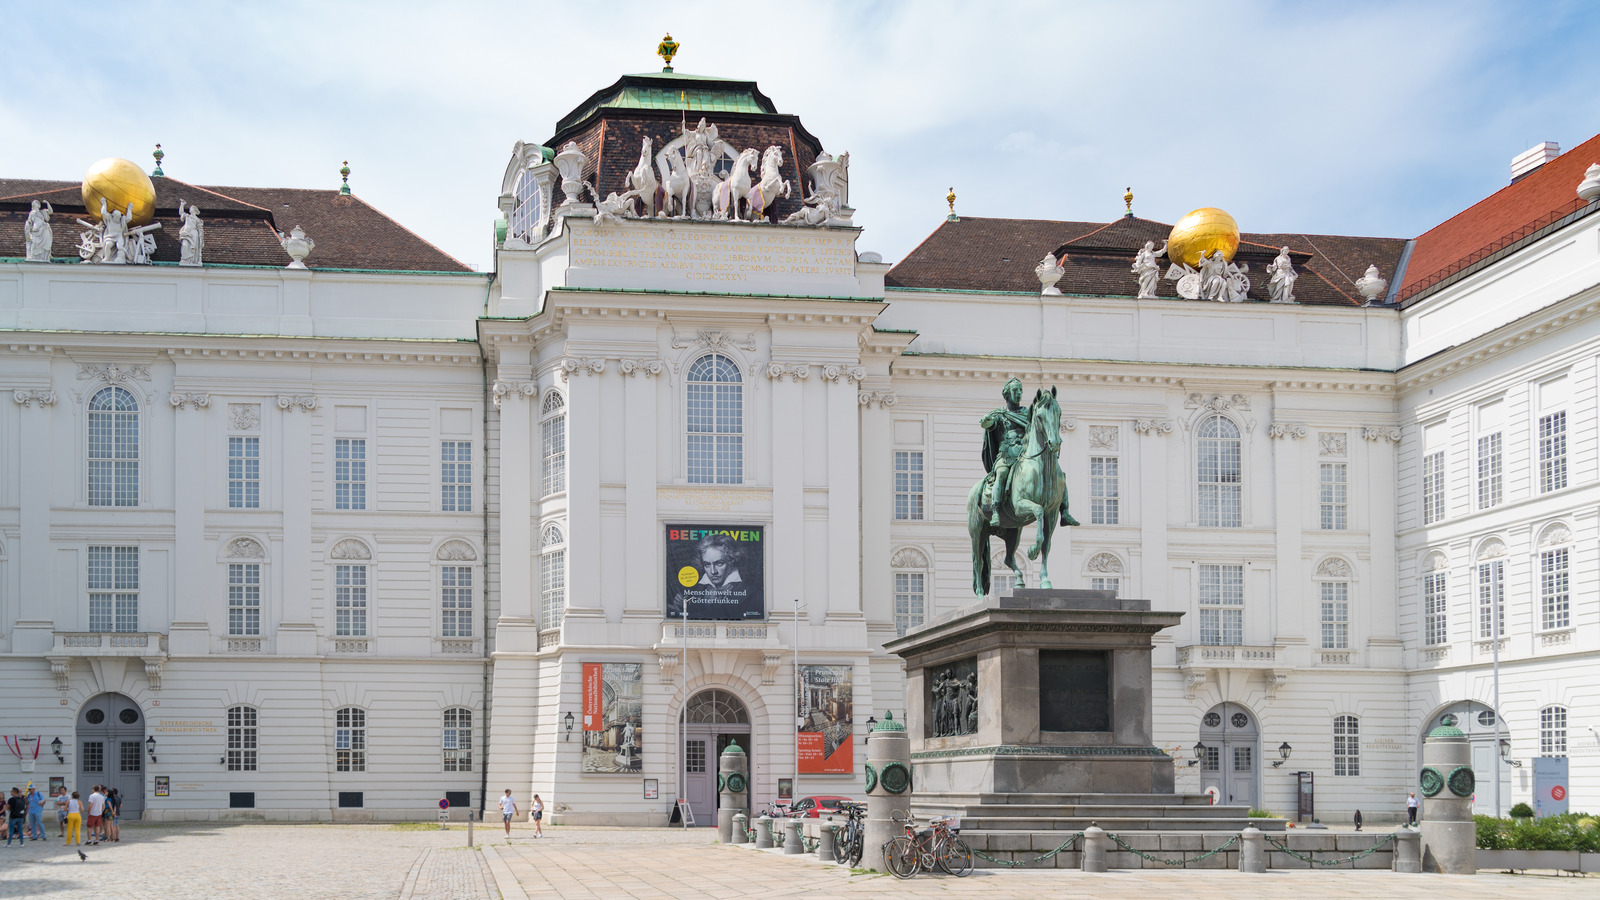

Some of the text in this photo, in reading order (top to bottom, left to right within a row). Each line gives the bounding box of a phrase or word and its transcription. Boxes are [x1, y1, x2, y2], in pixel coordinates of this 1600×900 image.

[574, 229, 615, 237] CAROLVS
[622, 230, 665, 240] AVSTRIVS
[642, 242, 690, 250] CONFECTO
[694, 243, 754, 252] INSTAVRANDIS
[820, 248, 852, 256] LITERIS
[684, 252, 719, 261] INGENTI
[724, 254, 772, 262] LIBRORVM
[778, 256, 808, 264] COPIA
[815, 257, 852, 266] AVCTAM
[698, 263, 734, 271] PVBLICO
[739, 264, 786, 273] COMMODO
[670, 530, 760, 542] BEETHOVEN
